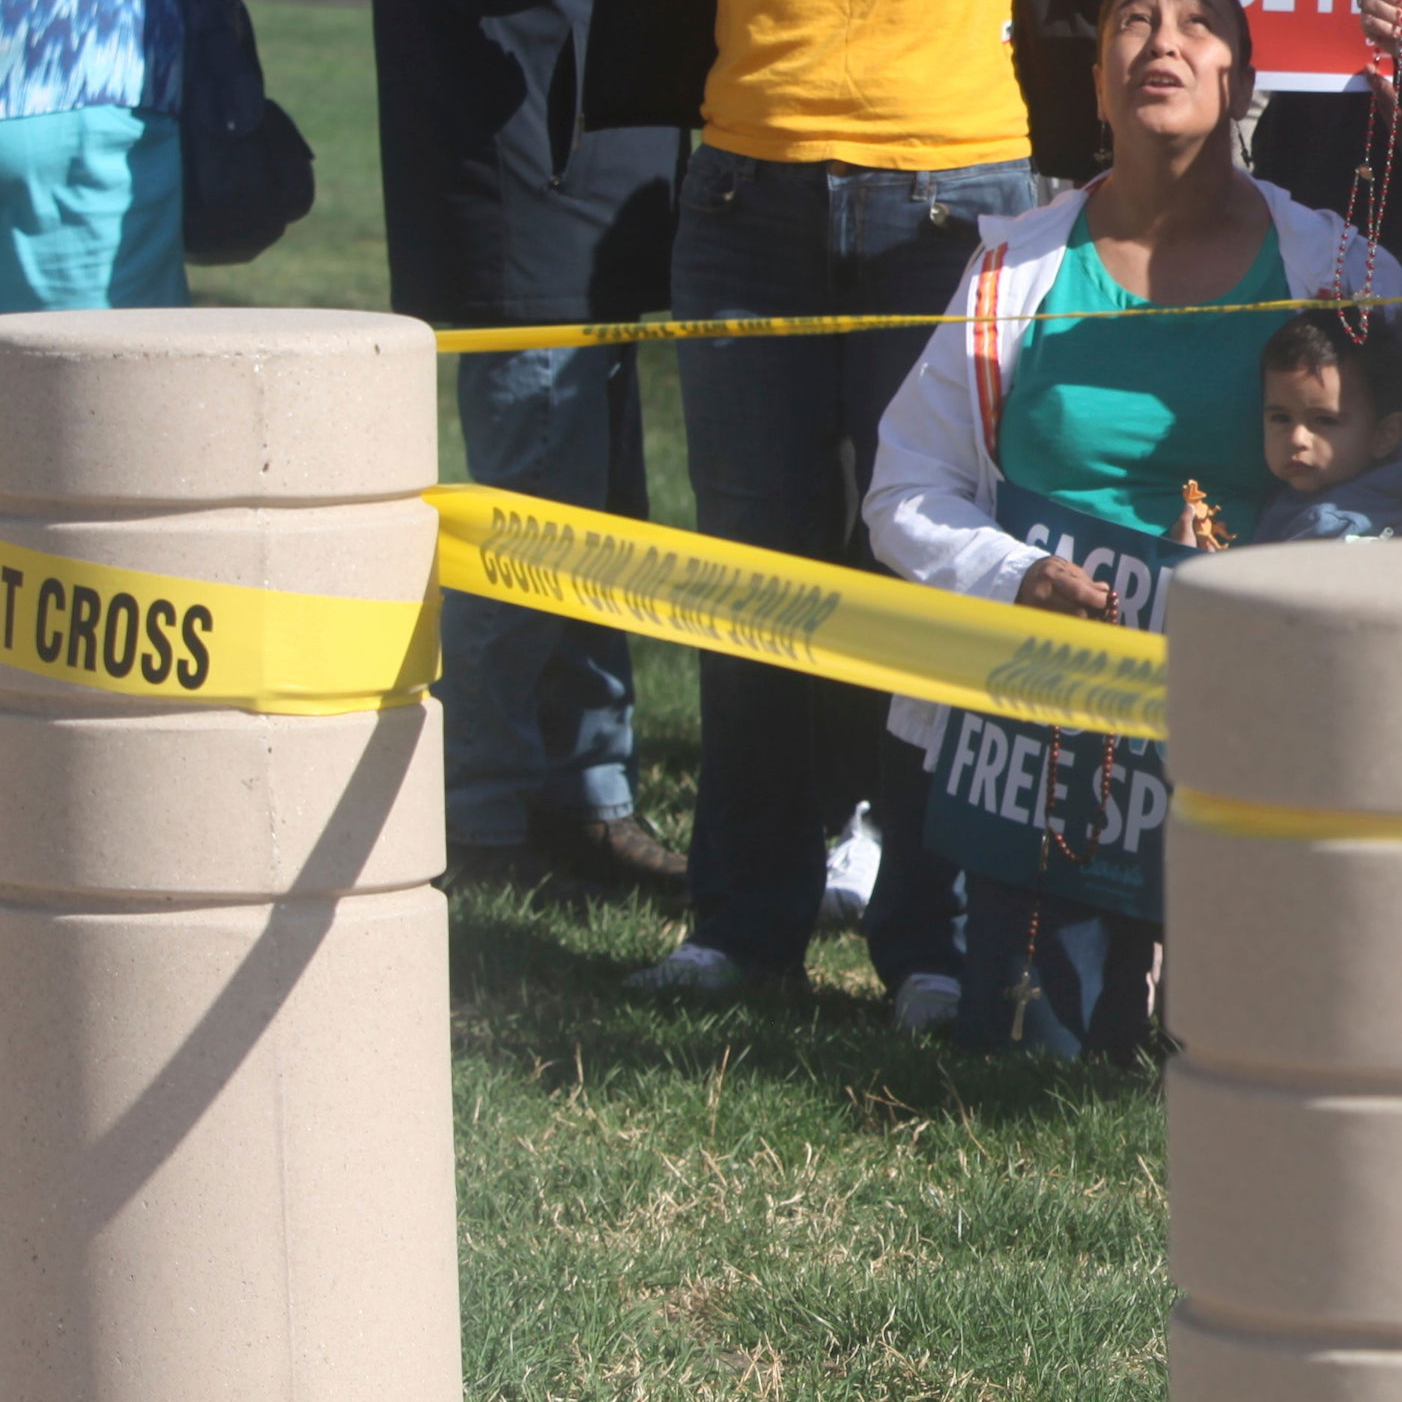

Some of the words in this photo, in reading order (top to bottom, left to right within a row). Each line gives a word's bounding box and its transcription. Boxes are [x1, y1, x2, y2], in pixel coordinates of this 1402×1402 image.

[1, 564, 24, 651] T
[36, 576, 214, 692] CROSS
[946, 711, 1075, 835] FREE
